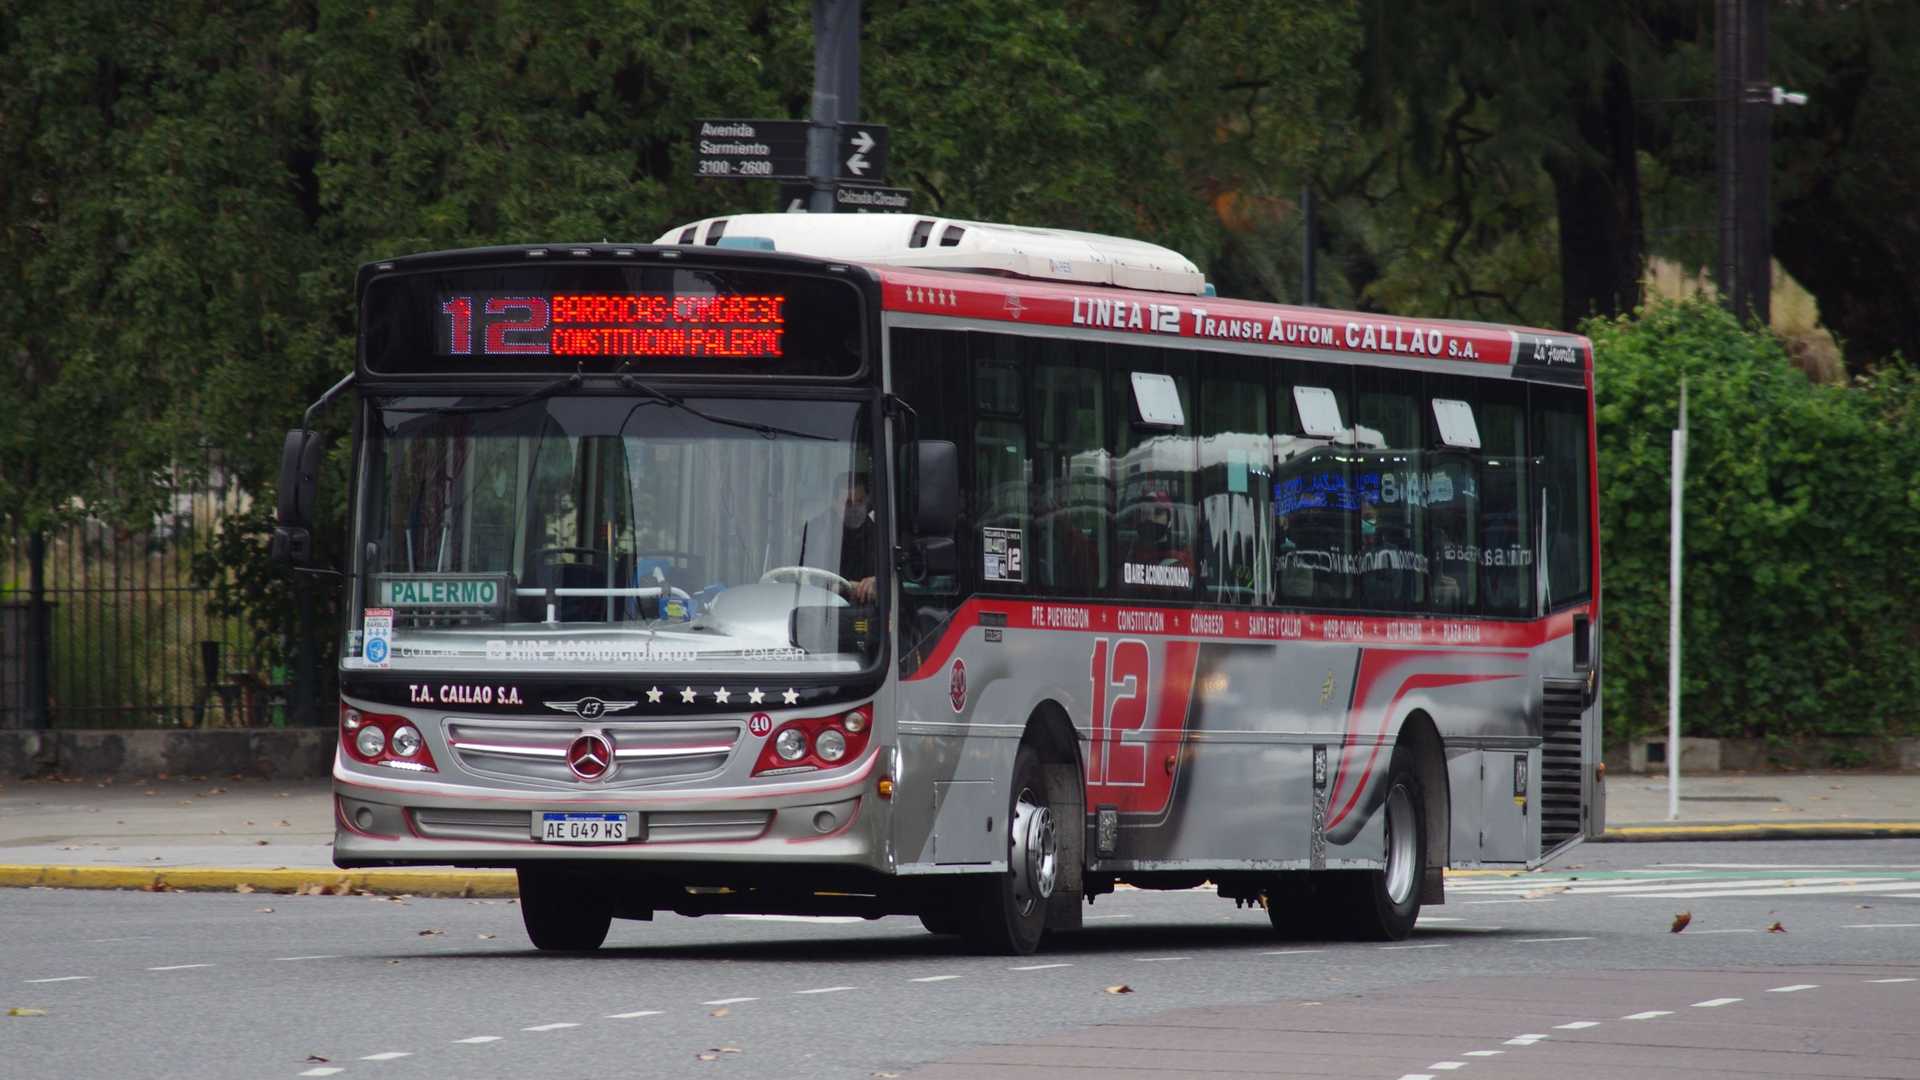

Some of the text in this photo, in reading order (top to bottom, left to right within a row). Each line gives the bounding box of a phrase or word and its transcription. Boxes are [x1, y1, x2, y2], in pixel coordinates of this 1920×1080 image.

[701, 122, 754, 137] Avenida
[700, 141, 770, 155] Sarmiento
[700, 160, 729, 174] 3100
[740, 161, 772, 175] 2600
[442, 296, 550, 354] 12
[1072, 296, 1143, 329] LINEA
[1149, 303, 1180, 333] 12
[1345, 322, 1444, 355] CALLAO
[1448, 341, 1479, 359] S.A.
[1007, 547, 1021, 571] 12
[390, 581, 496, 603] PALERMO
[1031, 606, 1089, 628] PTE. PUEYRREDON
[1117, 611, 1165, 631] CONSTITUCION
[1190, 614, 1224, 634] CONGRESO
[1248, 616, 1267, 635] SANTA
[1280, 618, 1301, 636] CALLAO
[508, 640, 549, 660] AIRE
[555, 640, 697, 662] ACONDICIONADO
[409, 685, 523, 705] T.A. CALLAO S.A.
[1087, 637, 1150, 786] 12
[750, 716, 769, 732] 40
[546, 823, 623, 838] AE 049 WS
